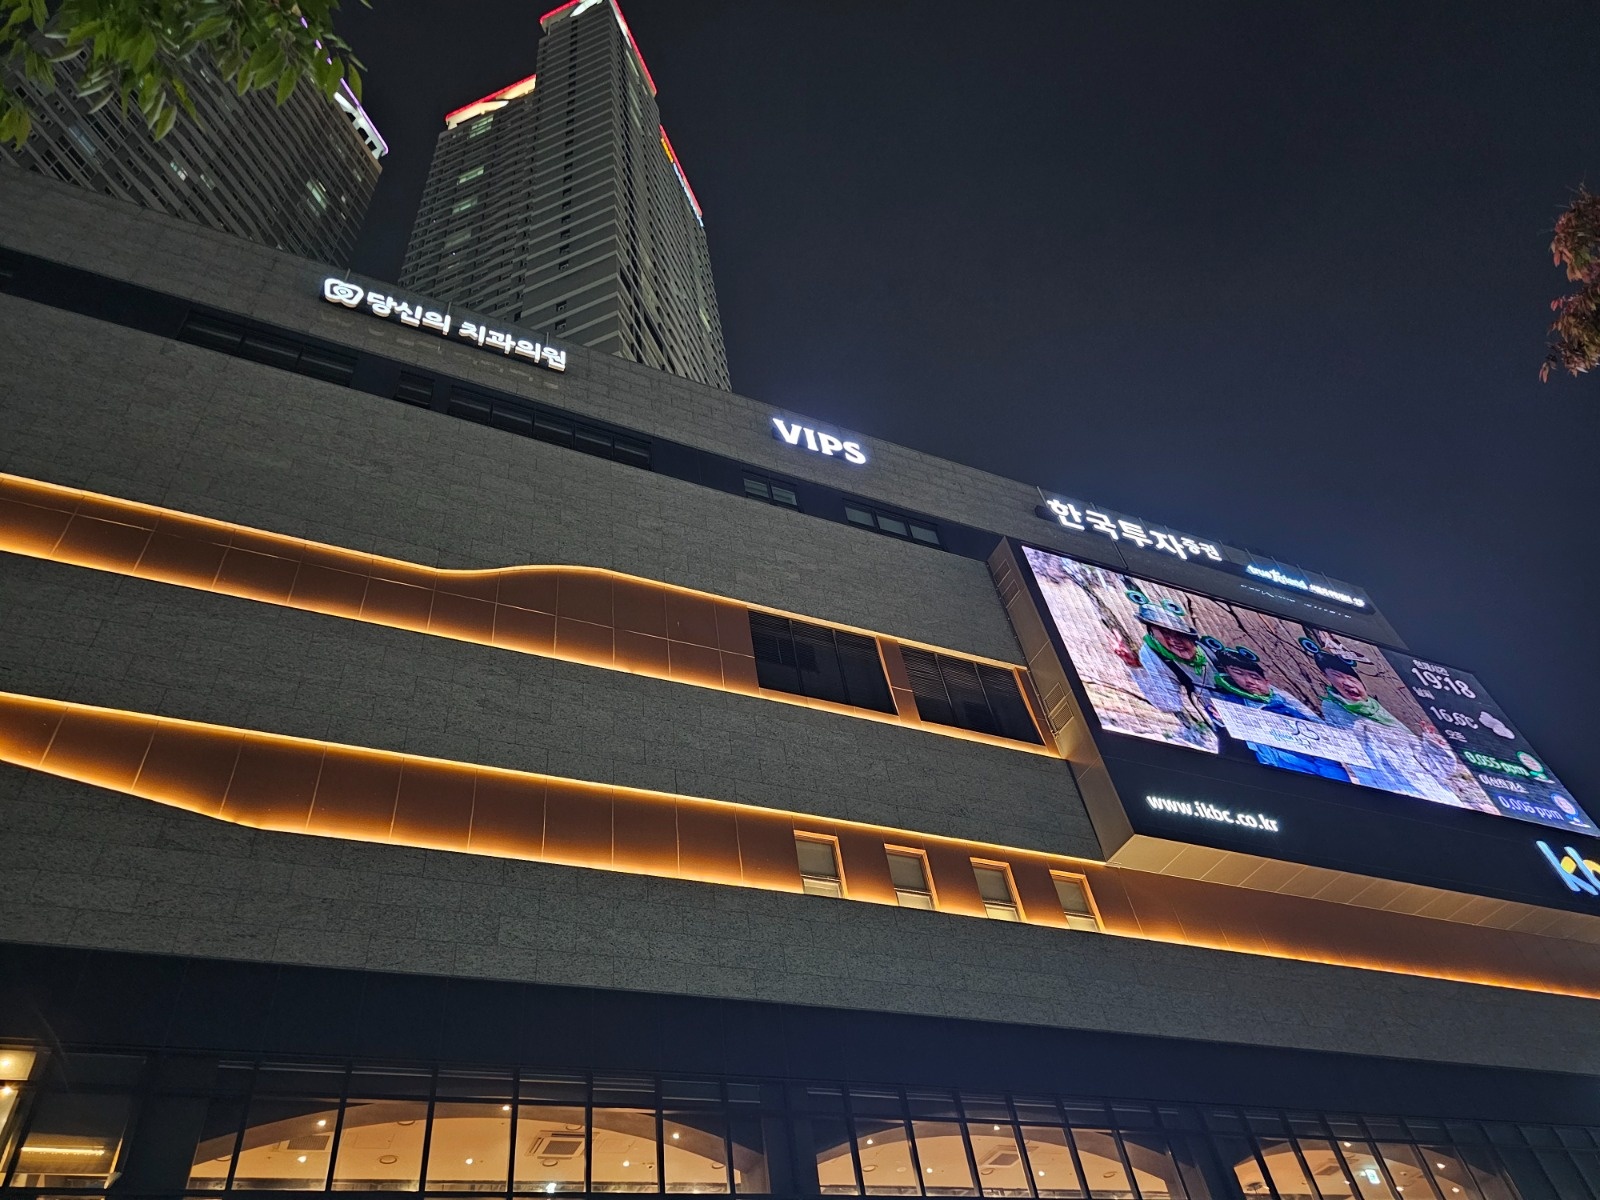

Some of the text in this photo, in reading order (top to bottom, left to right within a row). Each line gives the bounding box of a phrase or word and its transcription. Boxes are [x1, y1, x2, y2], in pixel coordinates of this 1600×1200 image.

[367, 291, 566, 371] 당신의 치과의원
[772, 418, 866, 465] VIPS
[1046, 499, 1222, 561] 한국투자증권
[1411, 668, 1477, 699] 19:18
[1500, 762, 1530, 777] ppm
[1145, 795, 1279, 832] www.ikbc.co.kr
[1534, 805, 1564, 821] ppm
